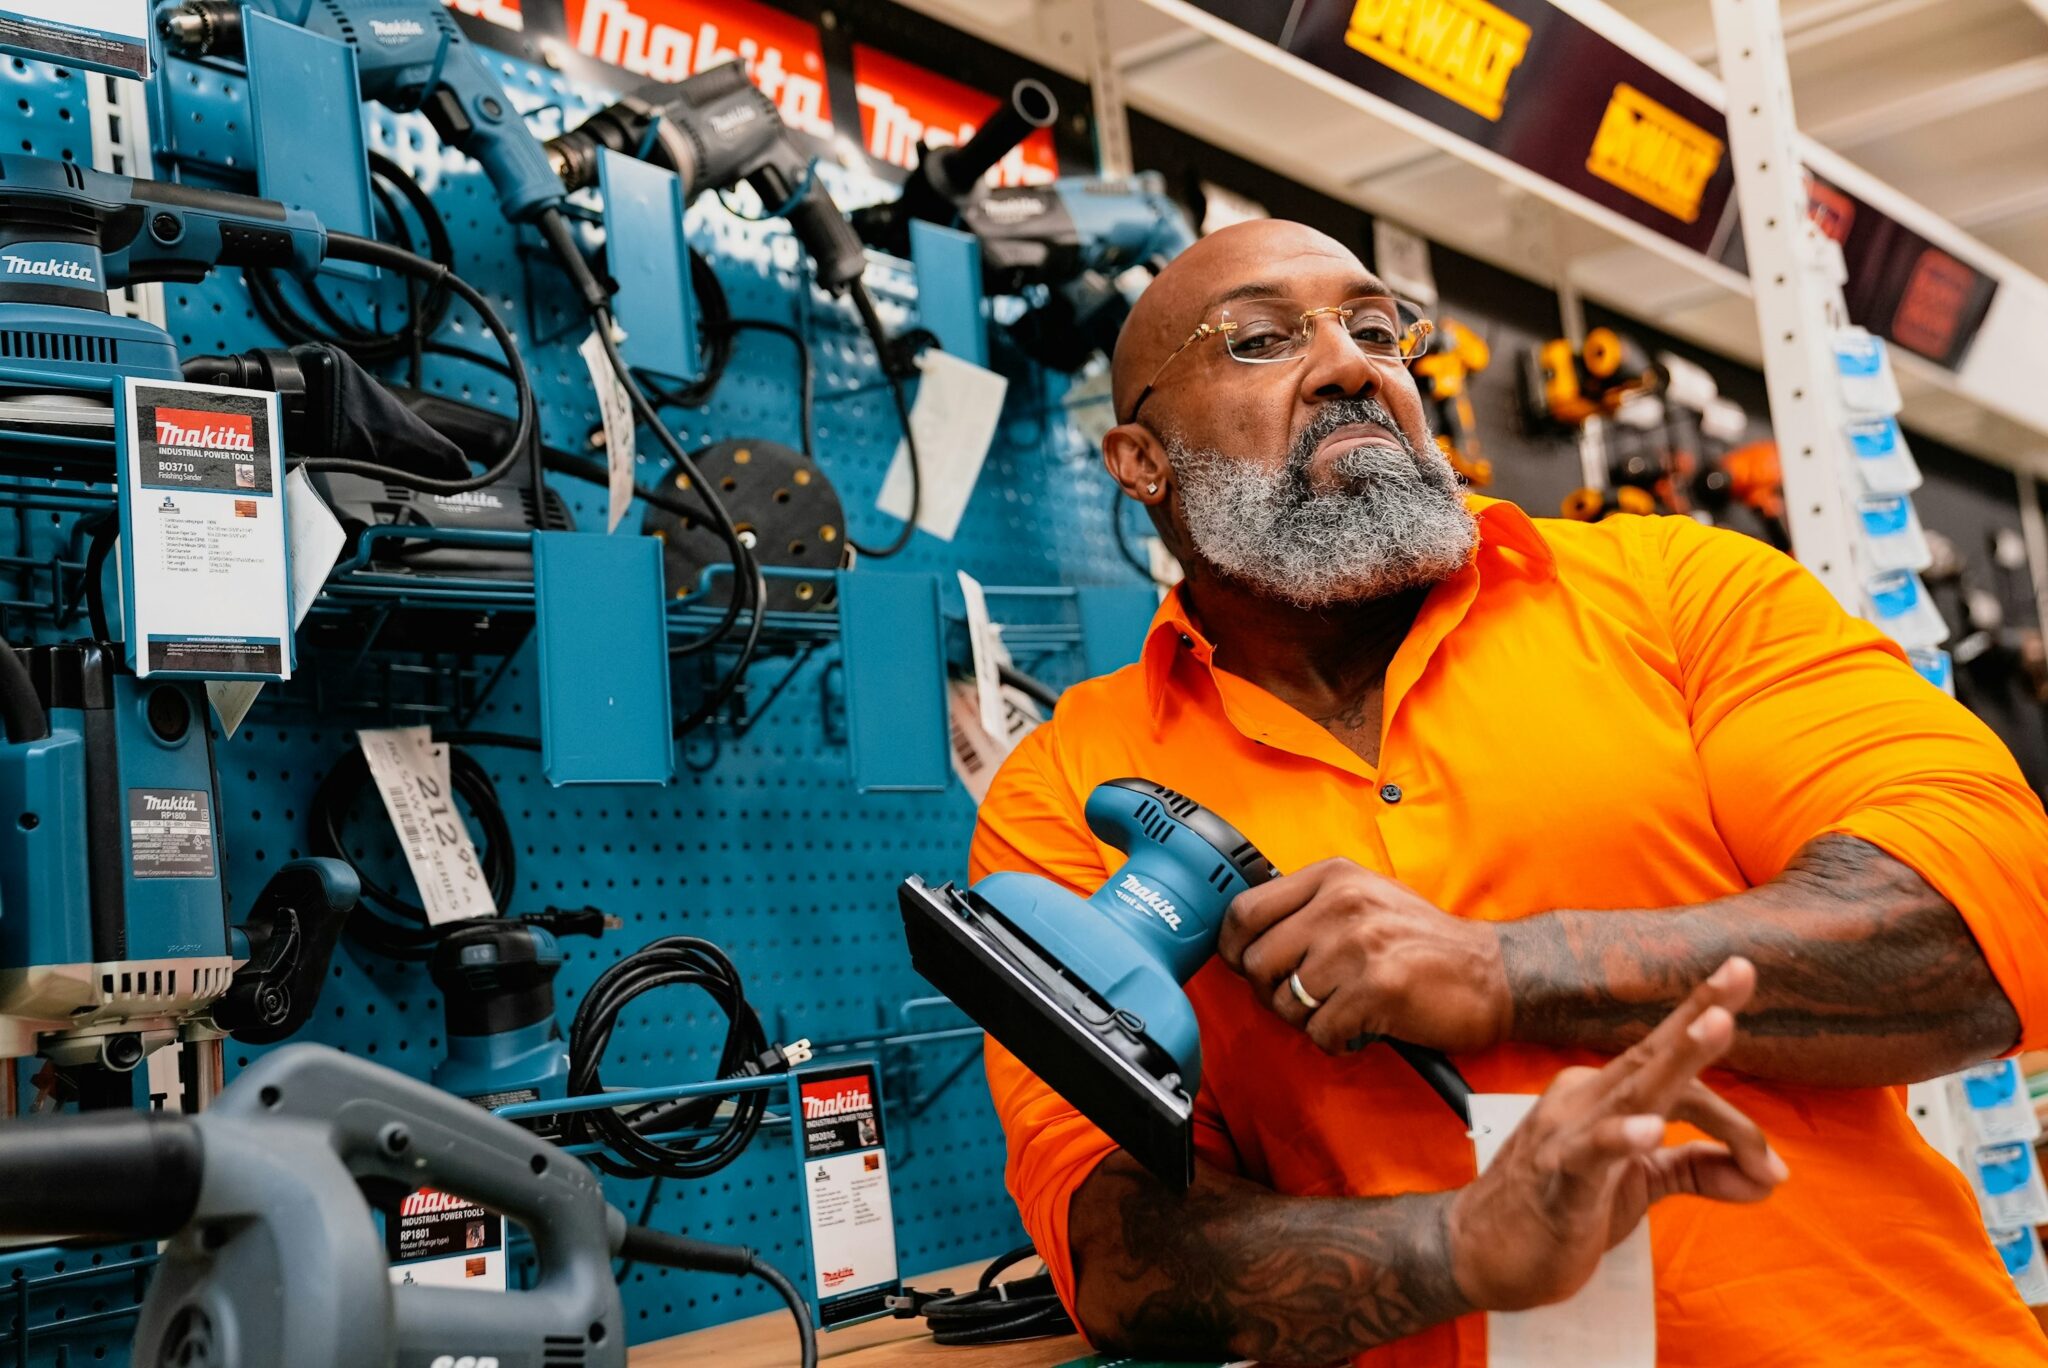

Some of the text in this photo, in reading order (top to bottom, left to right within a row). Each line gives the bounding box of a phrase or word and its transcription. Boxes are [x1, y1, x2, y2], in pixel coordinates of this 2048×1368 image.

[159, 447, 254, 461] INDUSTRIAL POWER TOOLS
[158, 461, 194, 472] BO3710
[158, 472, 202, 481] Finishing Sander
[161, 812, 186, 820] RP1800
[415, 776, 458, 846] 212
[458, 848, 478, 881] 99
[402, 770, 421, 811] SAW
[417, 815, 436, 843] MT
[434, 850, 460, 911] SERIES
[806, 1111, 874, 1129] INDUSTRIAL POWER TOOLS
[402, 1208, 485, 1227] INDUSTRIAL POWER TOOLS
[400, 1228, 430, 1241] RP1801
[400, 1236, 450, 1250] Router (Plunge type)
